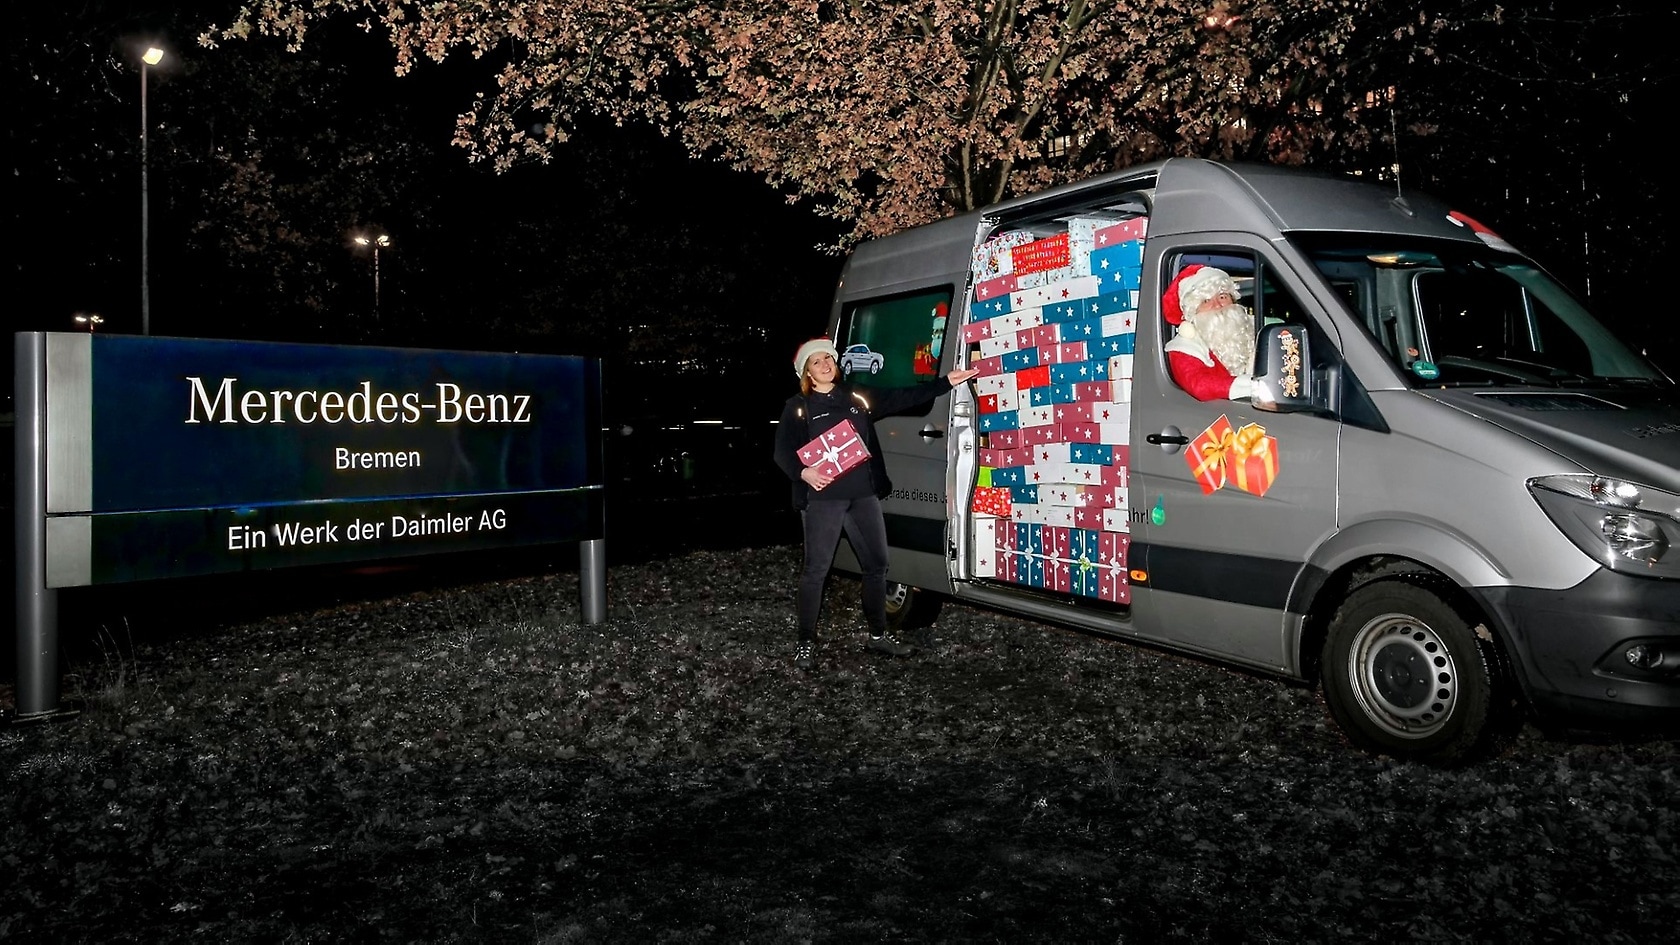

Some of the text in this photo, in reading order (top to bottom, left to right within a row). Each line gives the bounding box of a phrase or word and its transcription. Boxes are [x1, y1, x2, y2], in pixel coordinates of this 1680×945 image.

[184, 376, 531, 424] Mercedes-Benz
[335, 447, 421, 470] Bremen
[912, 488, 938, 502] dieses
[228, 508, 507, 550] Ein Werk der Daimler AG
